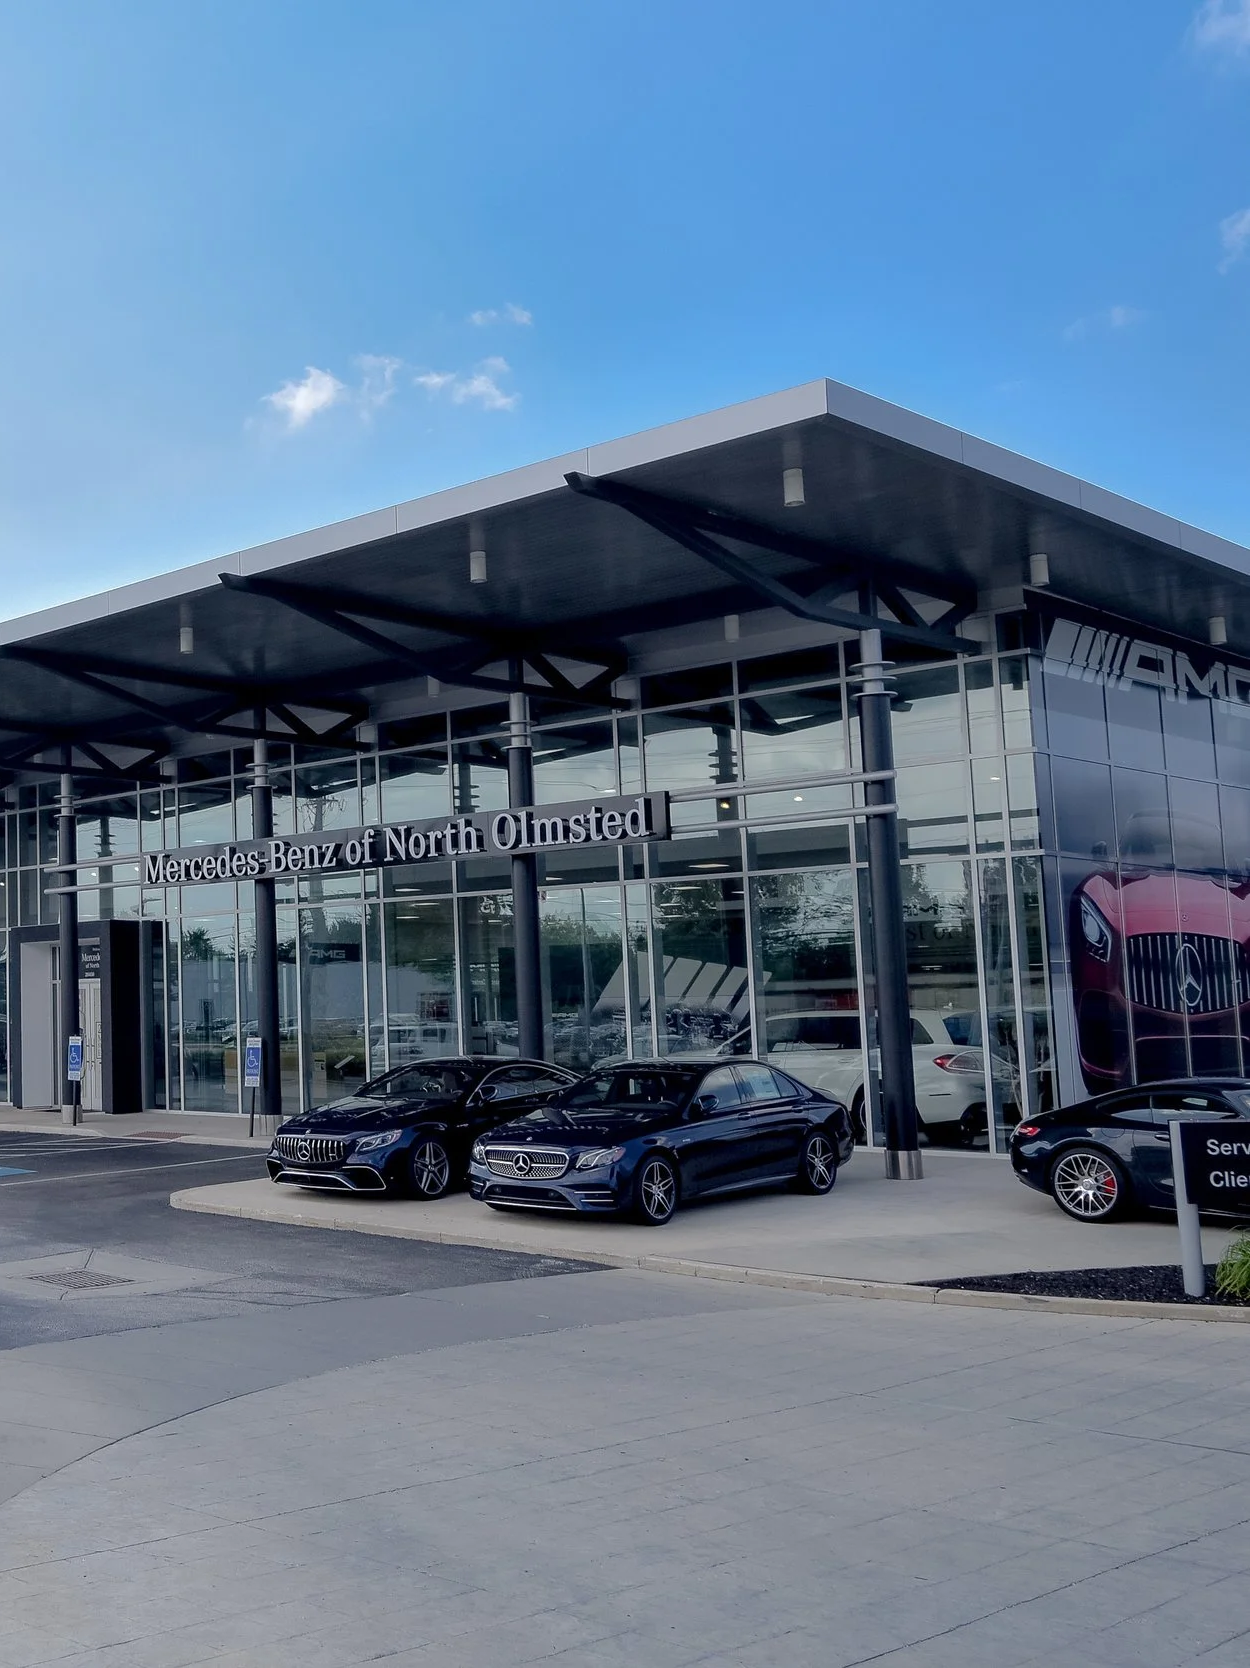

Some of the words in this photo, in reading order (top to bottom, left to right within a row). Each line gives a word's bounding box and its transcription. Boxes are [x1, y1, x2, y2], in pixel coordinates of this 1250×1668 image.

[143, 840, 337, 884] Mercedes-Benz
[345, 829, 375, 866] of
[383, 818, 481, 862] North
[491, 797, 650, 850] Olmsted
[1206, 1139, 1250, 1155] Serv
[1210, 1171, 1250, 1187] Clie
